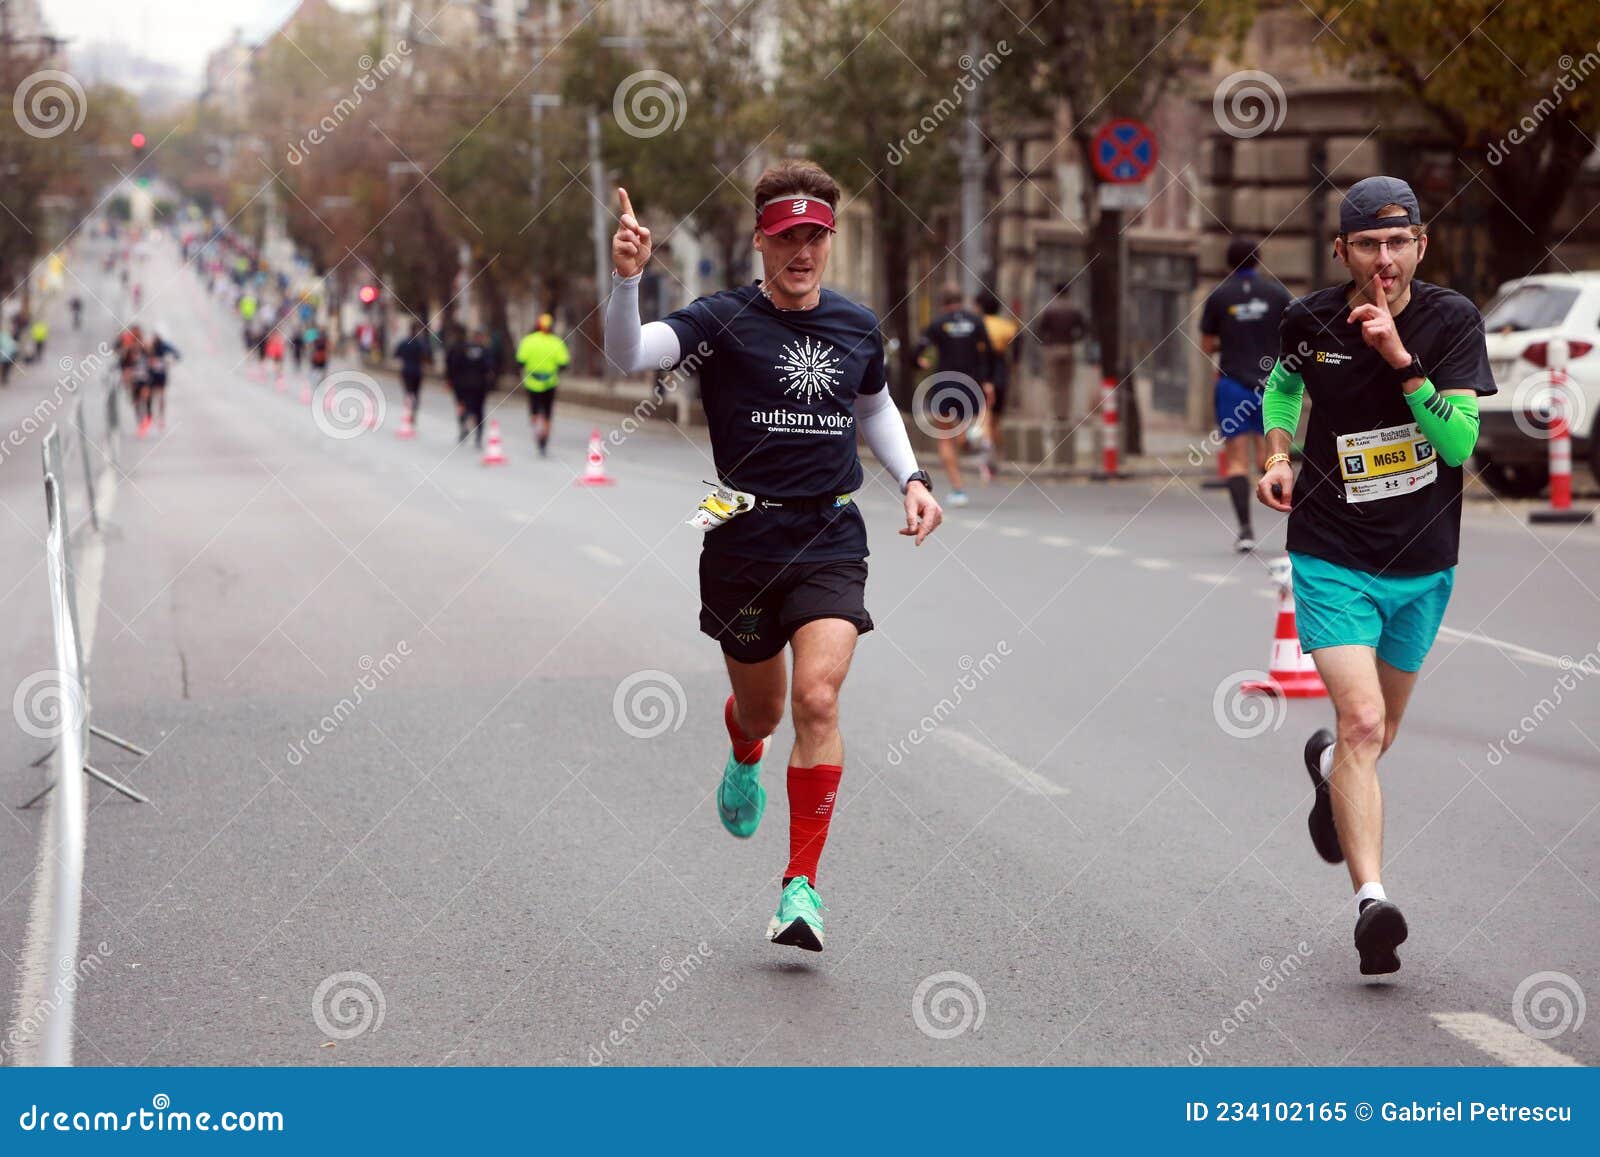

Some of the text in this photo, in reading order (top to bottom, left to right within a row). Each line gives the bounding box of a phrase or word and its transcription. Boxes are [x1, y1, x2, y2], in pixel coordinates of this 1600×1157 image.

[751, 409, 853, 428] autism voice
[1373, 450, 1407, 467] M653
